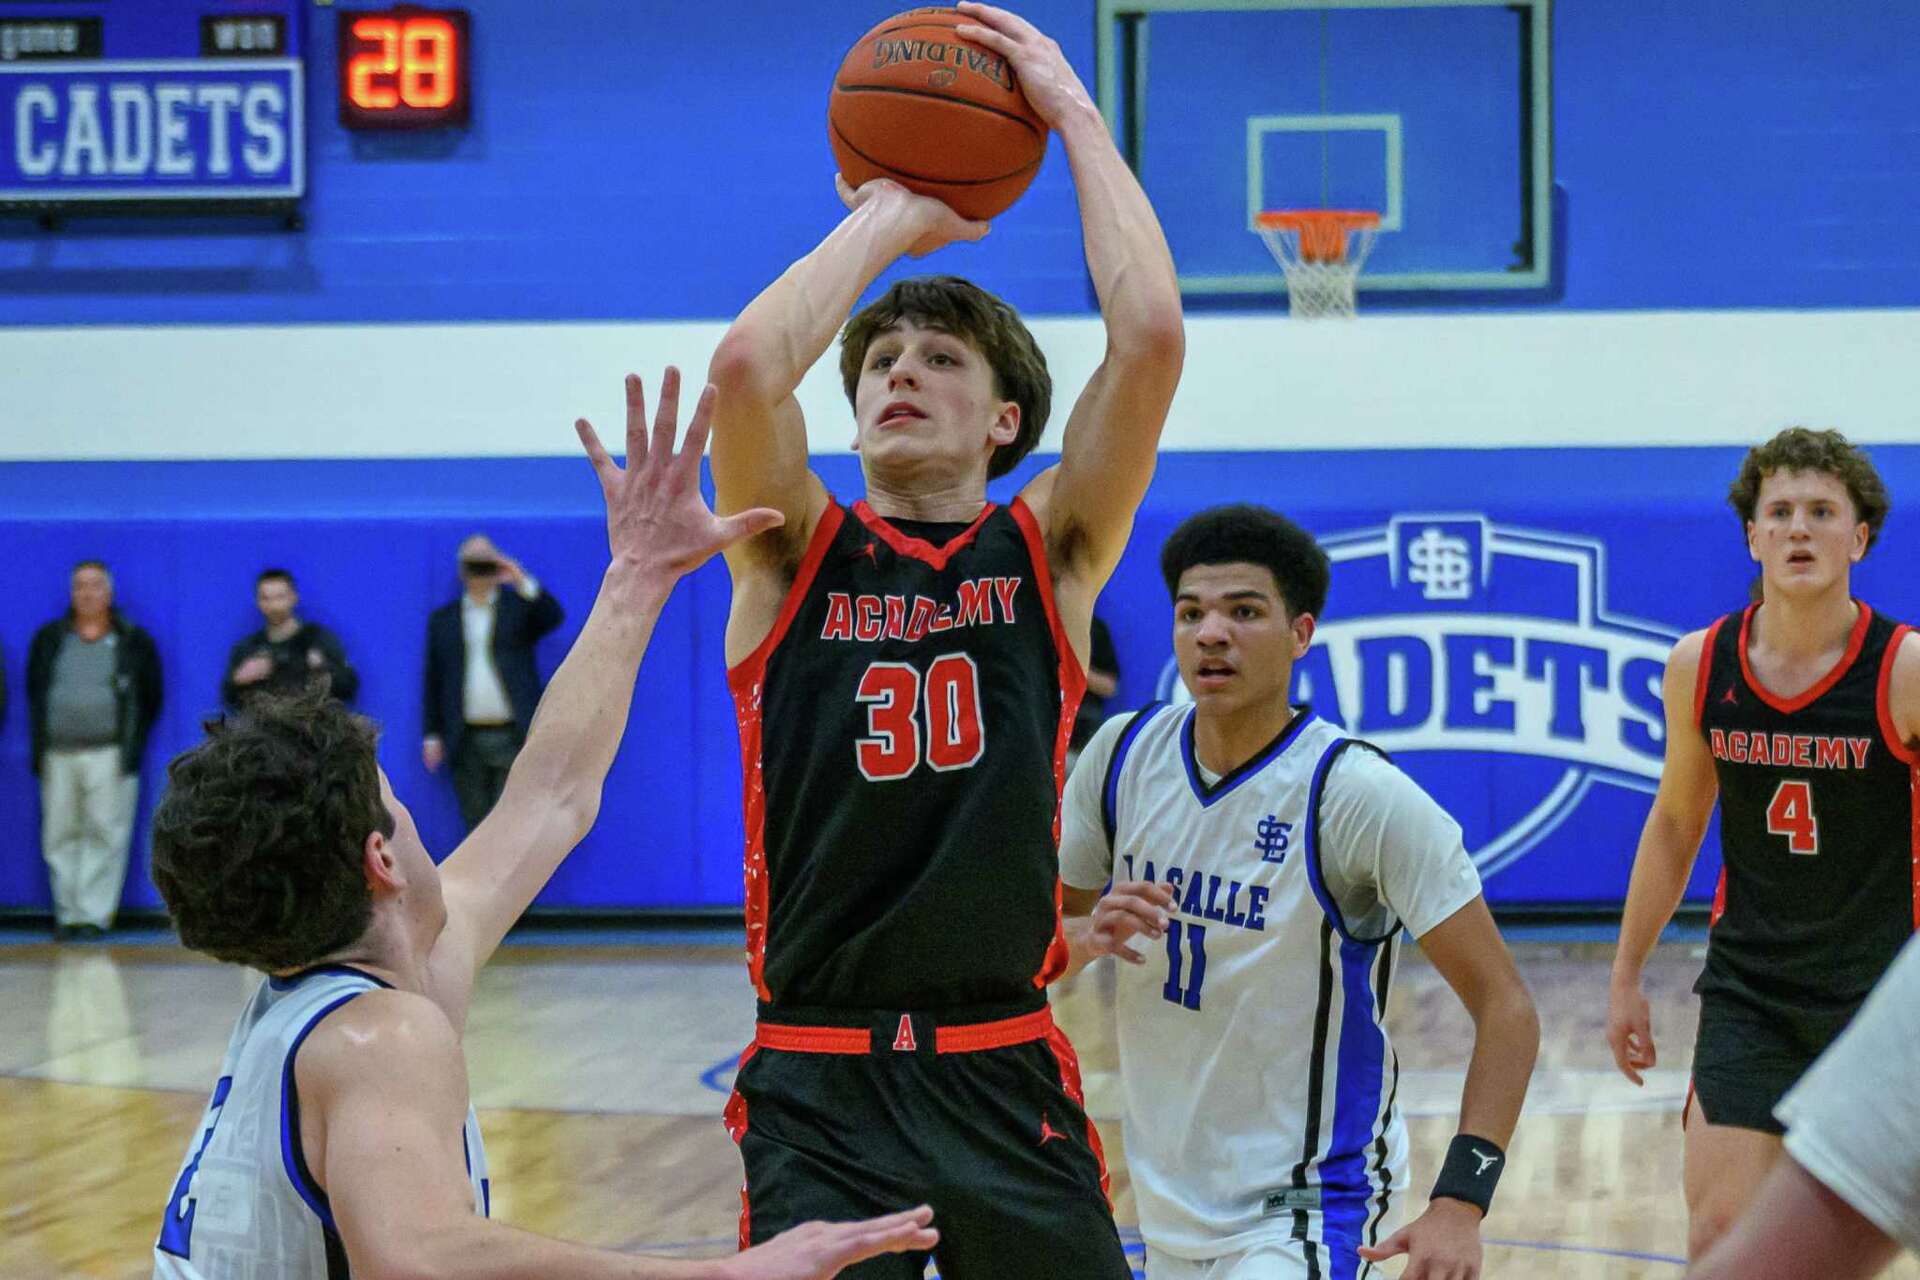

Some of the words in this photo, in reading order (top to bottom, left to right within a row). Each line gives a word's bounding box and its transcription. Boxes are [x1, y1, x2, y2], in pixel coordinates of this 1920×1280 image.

[349, 18, 457, 109] 28
[872, 38, 1006, 88] PALDING
[15, 82, 286, 176] CADETS
[820, 576, 1022, 642] ACADEMY
[855, 651, 985, 782] 30
[1288, 634, 1667, 760] ADETS
[1709, 728, 1872, 769] ACADEMY
[1765, 779, 1819, 855] 4
[1162, 917, 1207, 1012] 11
[892, 1013, 917, 1051] A
